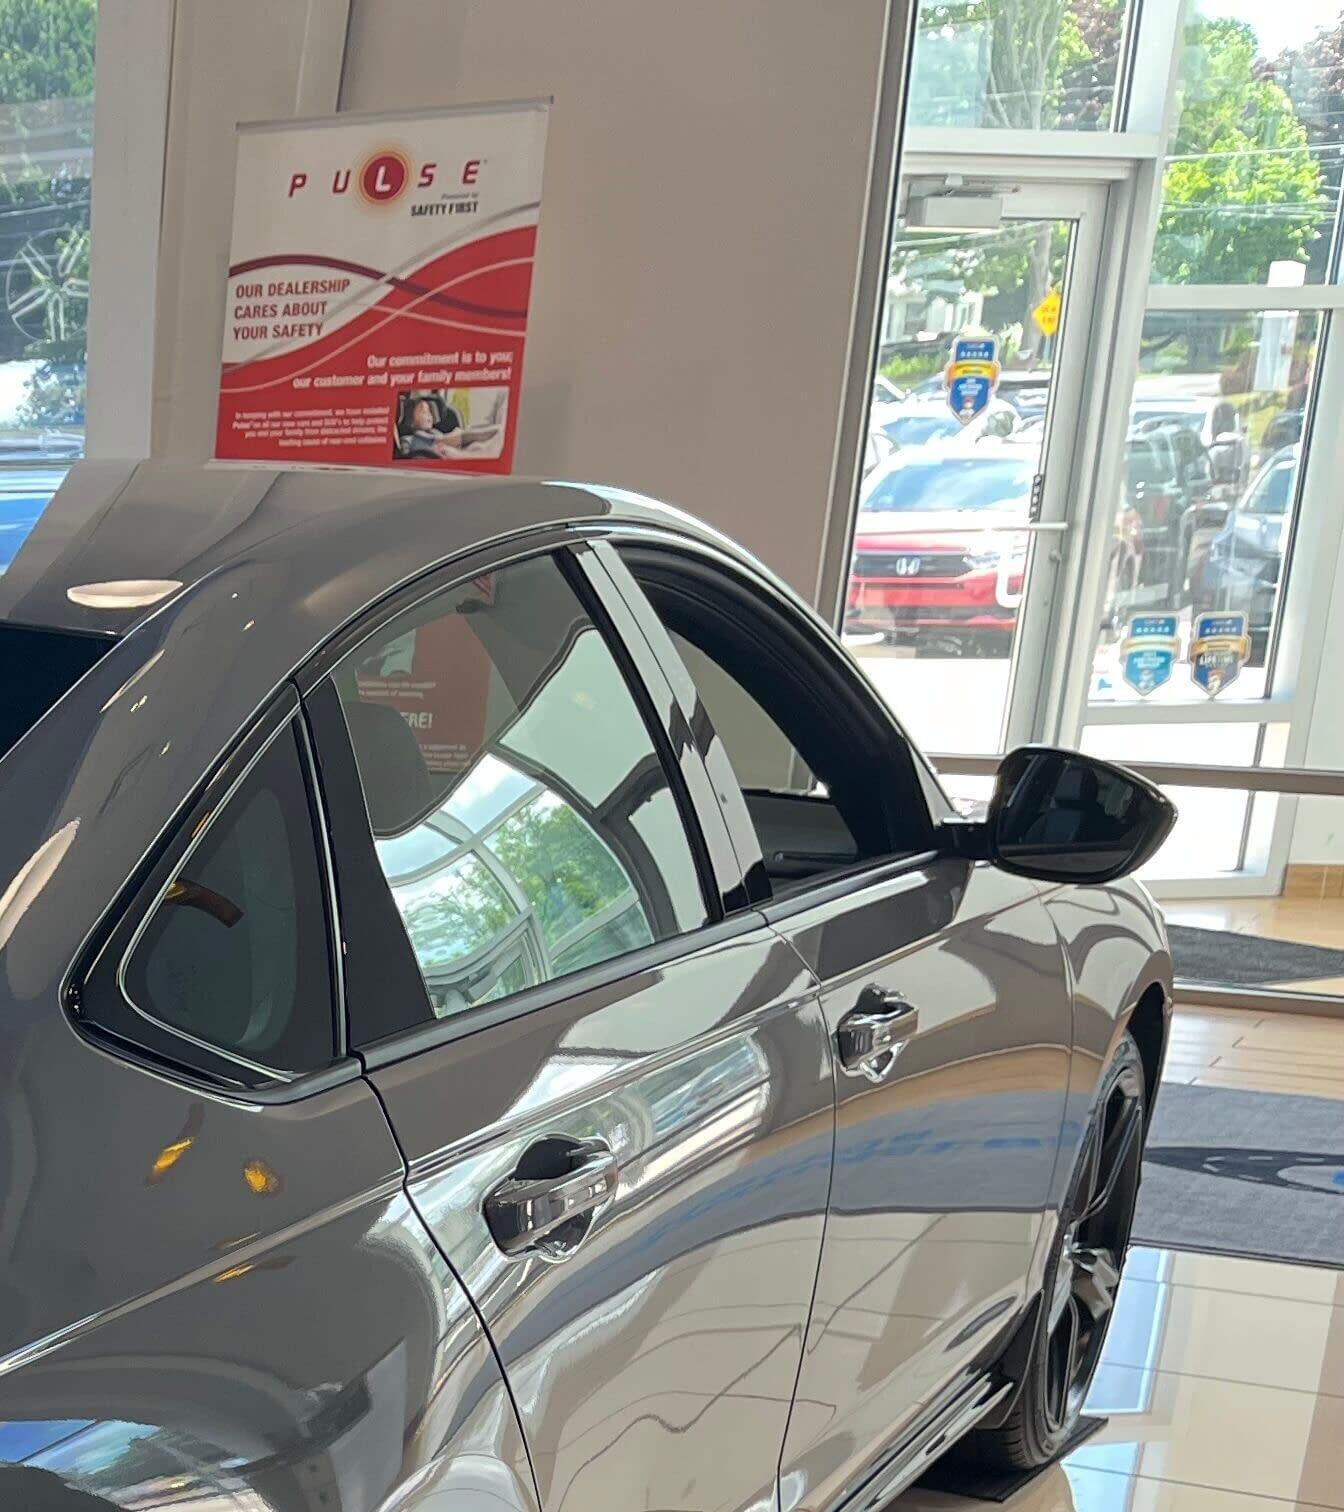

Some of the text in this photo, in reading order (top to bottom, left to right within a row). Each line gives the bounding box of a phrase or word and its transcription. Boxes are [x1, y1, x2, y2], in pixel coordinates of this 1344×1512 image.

[288, 159, 481, 198] PULSE
[411, 201, 479, 217] SAFETY FIRST
[236, 279, 350, 298] OUR DEALERSHIP
[234, 301, 327, 319] CARES ABOUT
[233, 322, 323, 340] YOUR SAFETY
[367, 353, 387, 368] Our
[389, 352, 460, 366] commitment
[462, 351, 472, 363] is
[475, 351, 487, 363] to
[313, 373, 364, 388] customer
[367, 371, 388, 385] and
[390, 373, 414, 387] your
[418, 369, 452, 384] family
